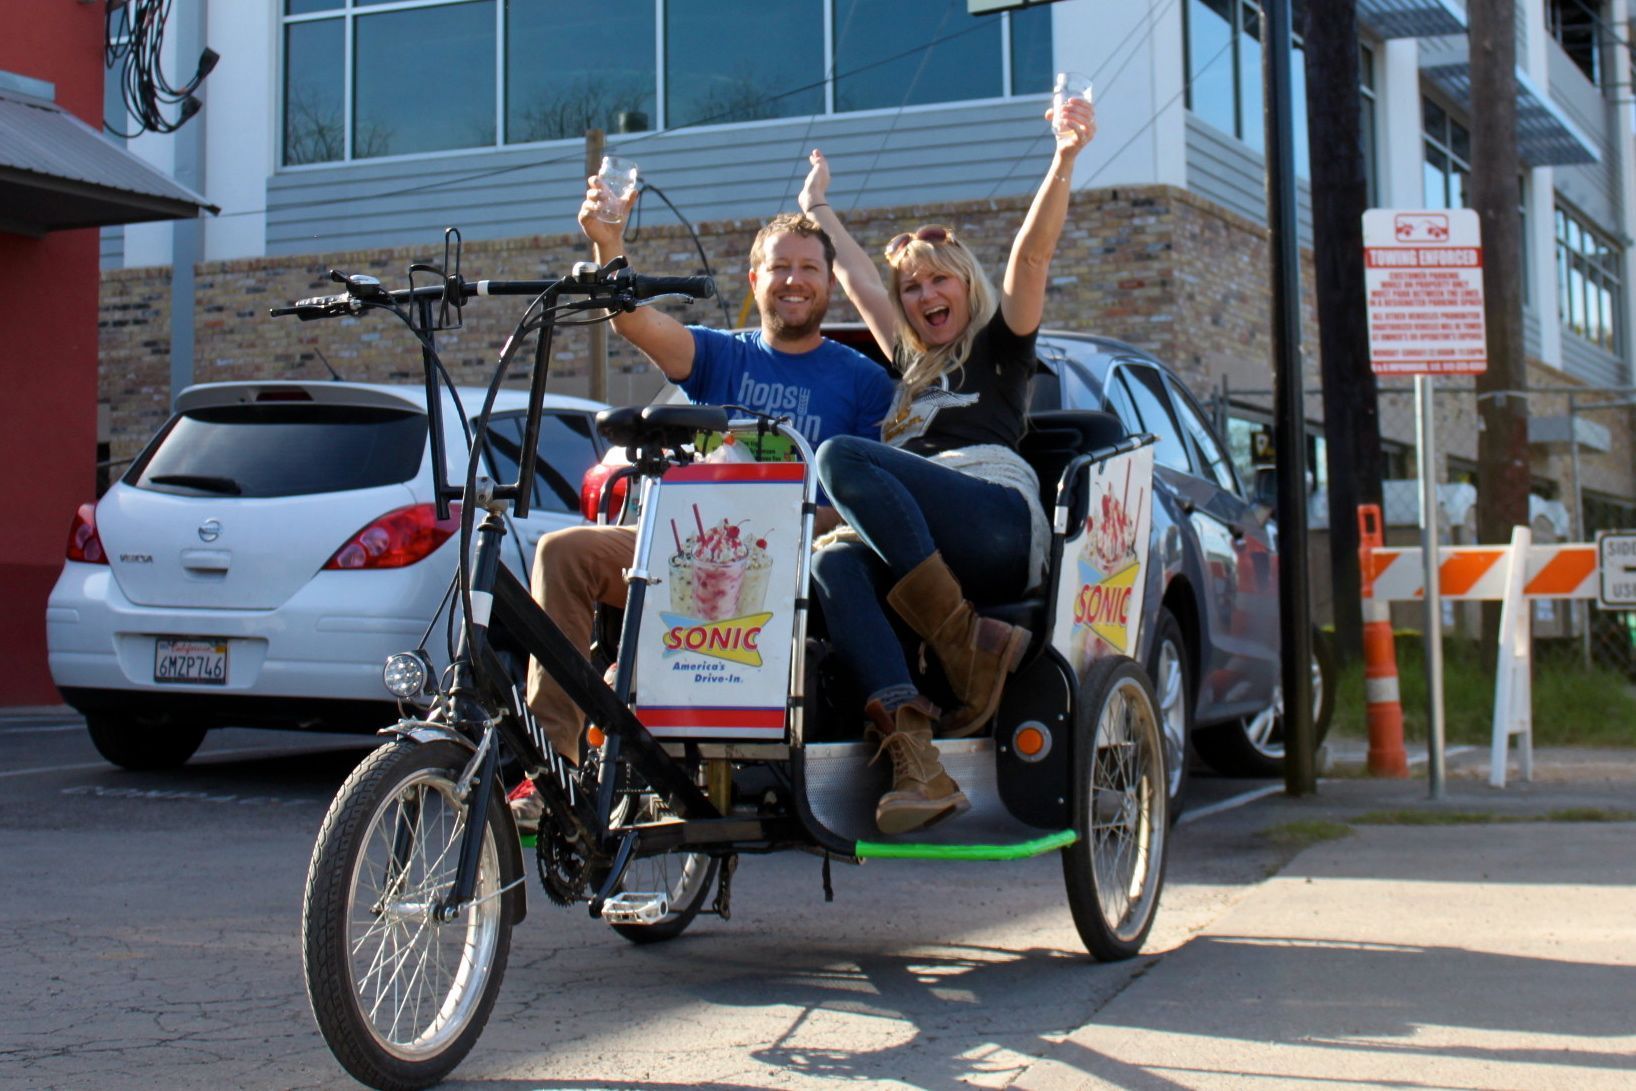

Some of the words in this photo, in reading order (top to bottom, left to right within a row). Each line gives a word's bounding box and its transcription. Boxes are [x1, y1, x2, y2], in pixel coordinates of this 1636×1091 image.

[1370, 249, 1417, 266] TOWING
[1419, 249, 1477, 266] ENFORCED
[737, 372, 799, 416] hops
[1074, 584, 1133, 625] SONIC
[665, 625, 762, 651] SONIC
[159, 655, 223, 678] 6MZP746
[672, 661, 726, 671] America's
